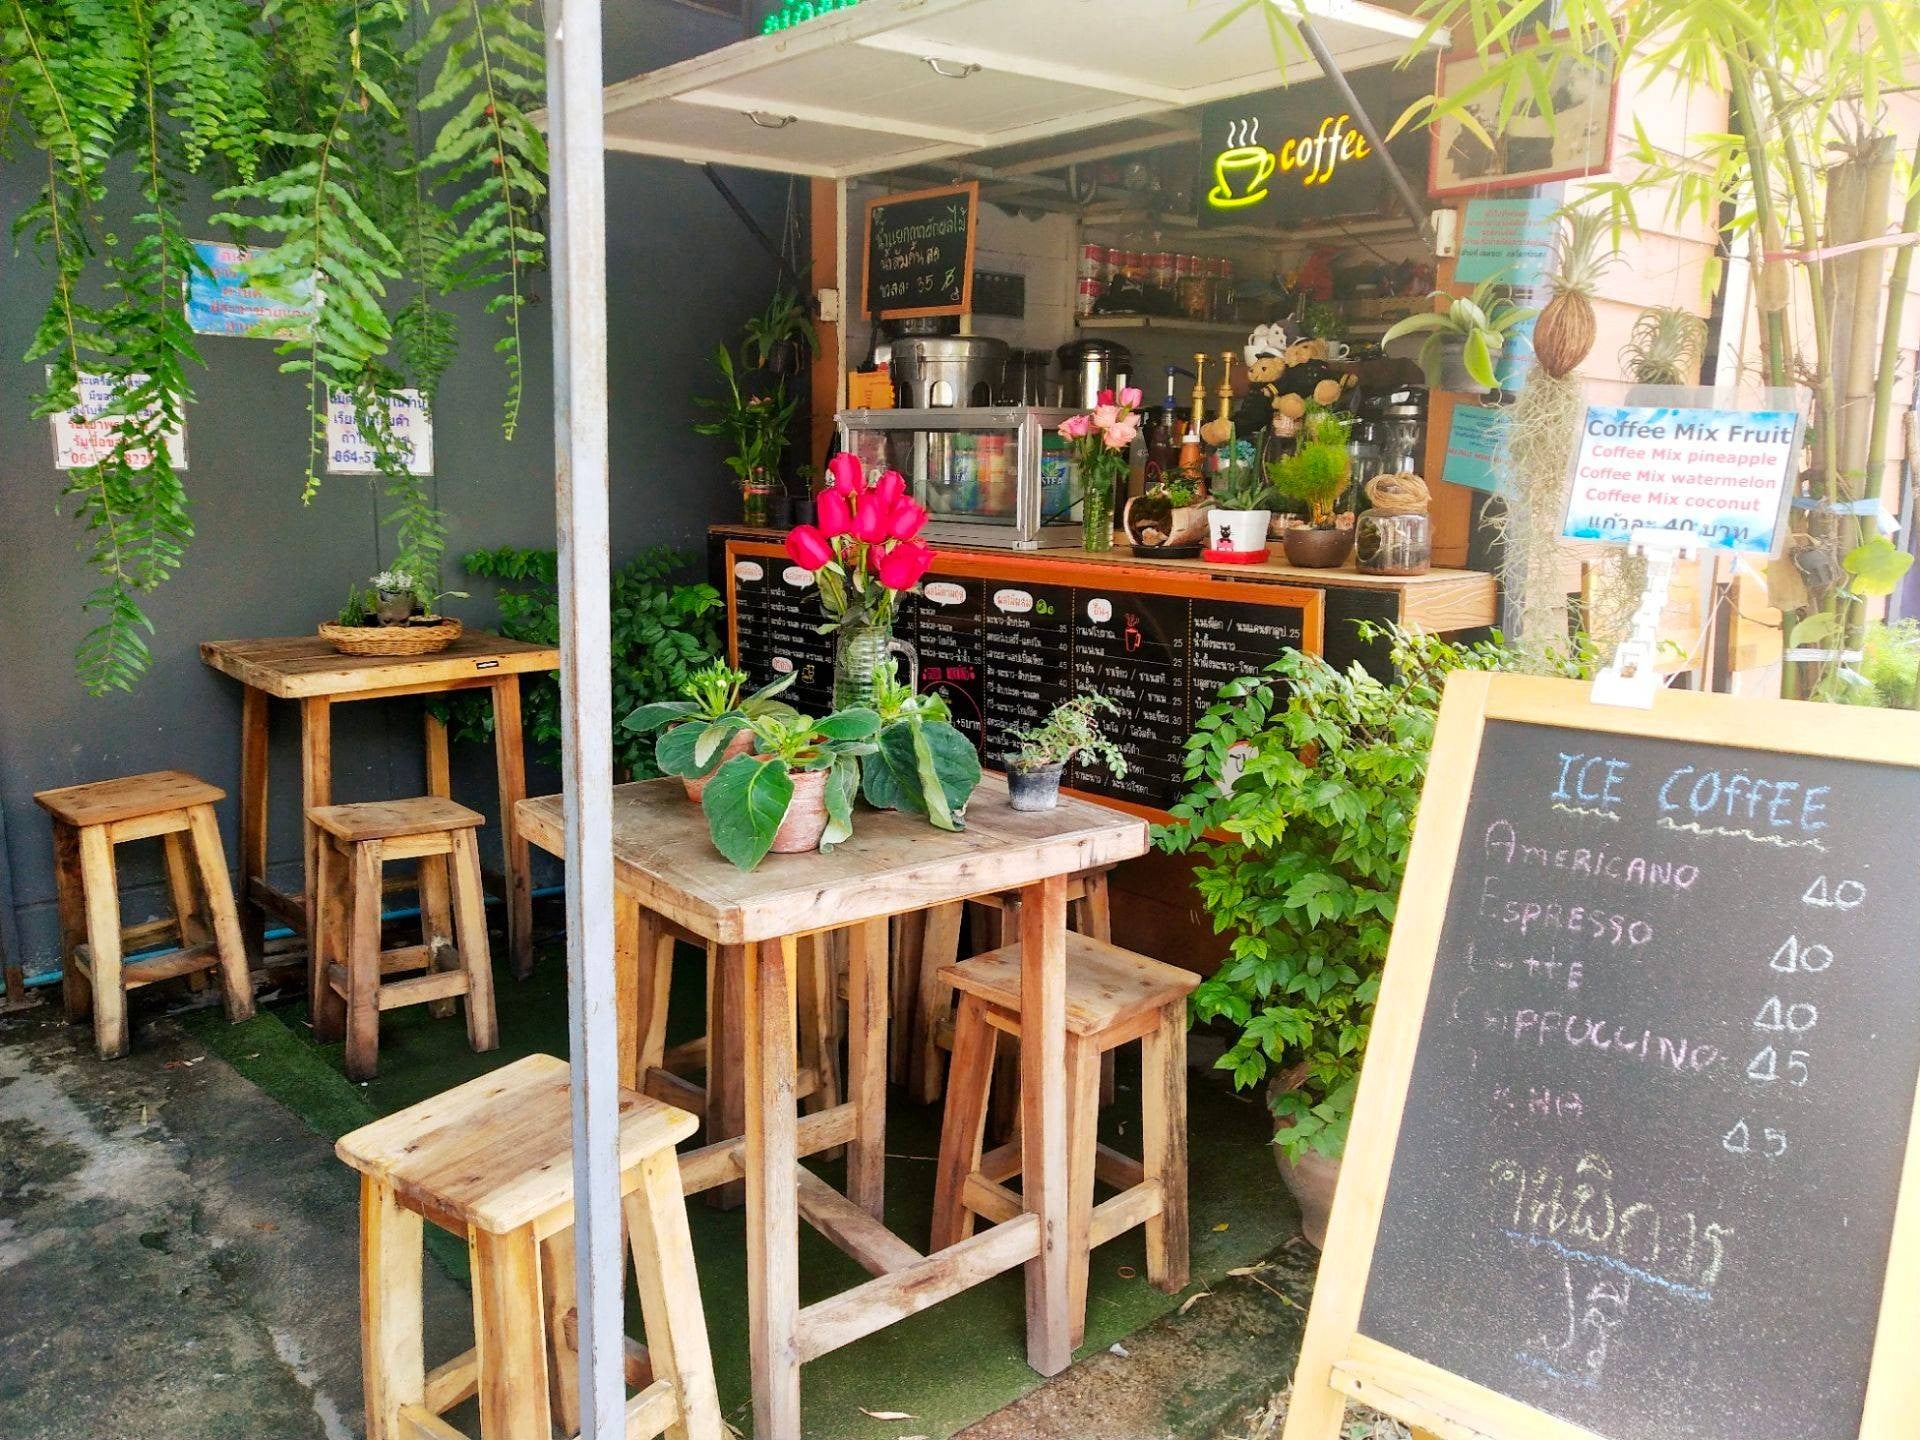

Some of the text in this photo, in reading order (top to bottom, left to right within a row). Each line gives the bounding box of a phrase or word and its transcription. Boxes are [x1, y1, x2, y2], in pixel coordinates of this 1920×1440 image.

[1280, 114, 1372, 186] coffee
[916, 274, 934, 293] 35
[1587, 420, 1793, 445] Coffee Mix Fruit
[1591, 444, 1778, 467] Coffee Mix pineapple
[1579, 466, 1777, 489] Coffee Mix watermelon
[1585, 487, 1761, 512] Coffee Mix coconut
[1697, 523, 1750, 540] บาท
[1173, 638, 1184, 648] 25
[1289, 629, 1301, 639] 25
[1172, 658, 1183, 668] 25
[1172, 677, 1183, 687] 25
[1172, 696, 1183, 706] 25
[1172, 716, 1183, 726] 30
[1171, 735, 1182, 745] 25
[1171, 773, 1181, 783] 25
[1550, 752, 1832, 832] ICE COFFEE
[1801, 873, 1868, 912] 40
[1769, 934, 1834, 973] 40
[1753, 995, 1818, 1033] 40
[1746, 1045, 1811, 1088] 45
[1722, 1118, 1788, 1159] 45
